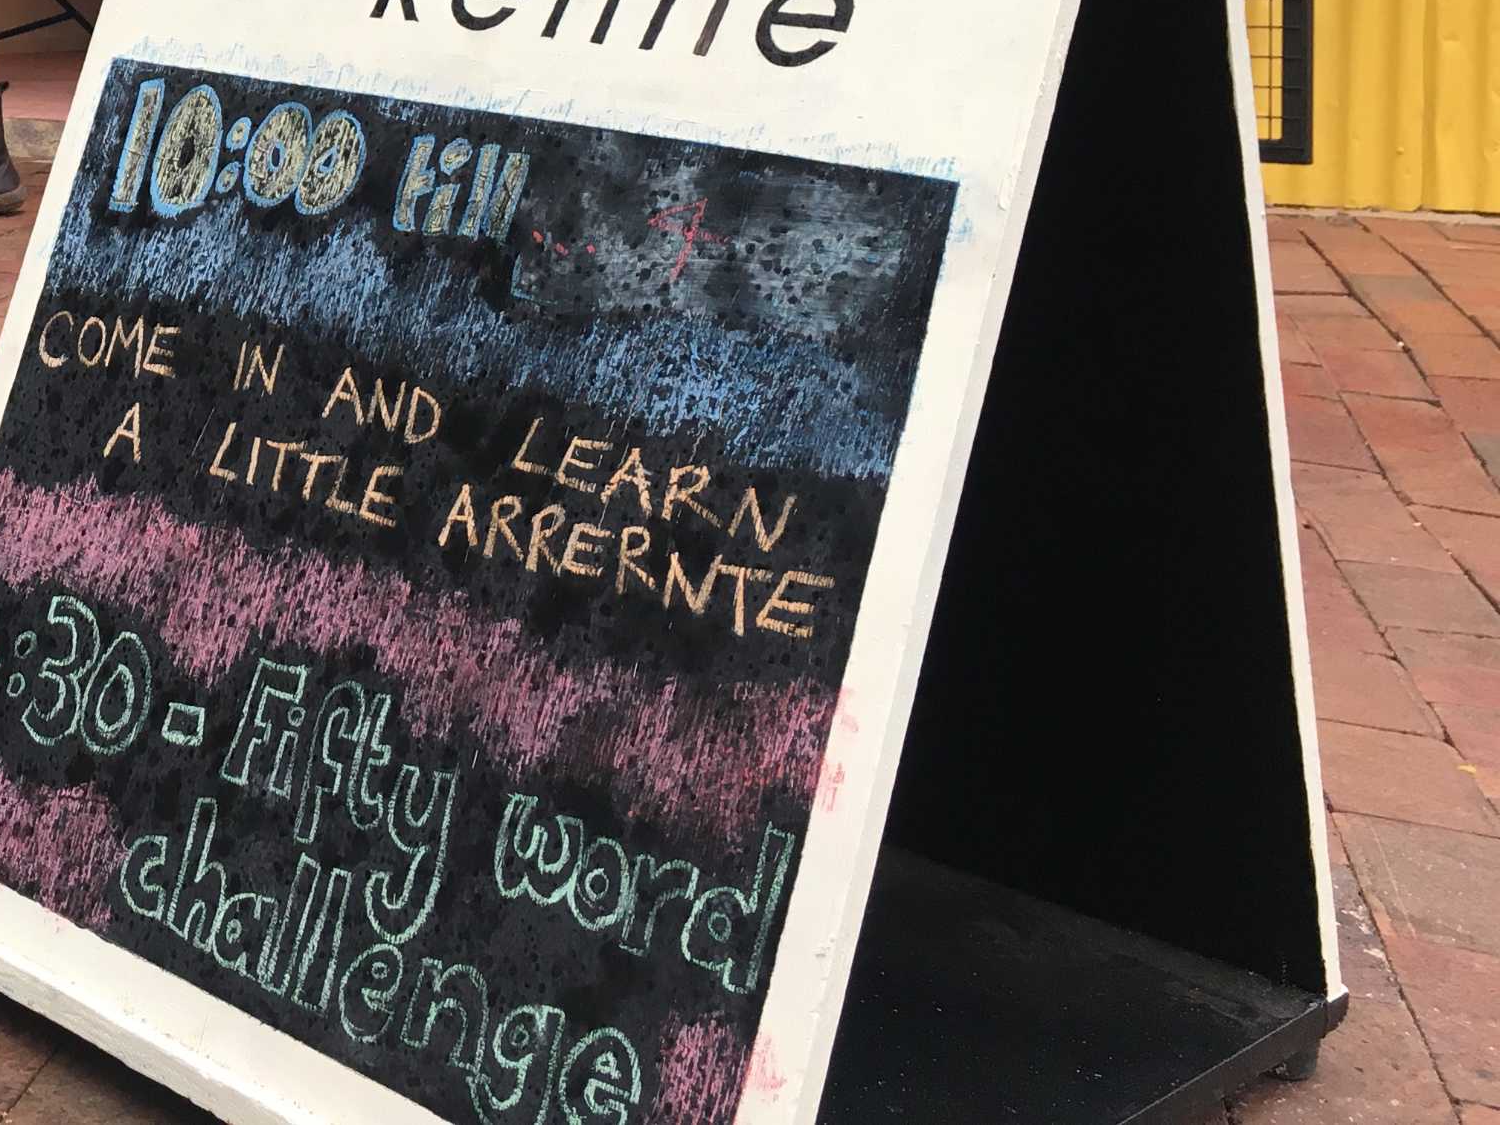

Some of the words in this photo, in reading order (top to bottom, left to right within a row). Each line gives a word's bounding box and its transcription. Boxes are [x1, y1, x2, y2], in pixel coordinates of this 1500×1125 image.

[108, 77, 367, 218] 10:00
[392, 132, 531, 243] till
[38, 310, 181, 378] COME
[232, 340, 286, 396] IN
[321, 366, 442, 444] AND
[511, 416, 797, 553] LEARN
[103, 401, 142, 464] A
[208, 421, 405, 528] LITTLE
[437, 482, 836, 638] ARRERNTE
[220, 658, 460, 944] Fifty
[494, 791, 795, 994] word
[120, 797, 642, 1125] challenge
